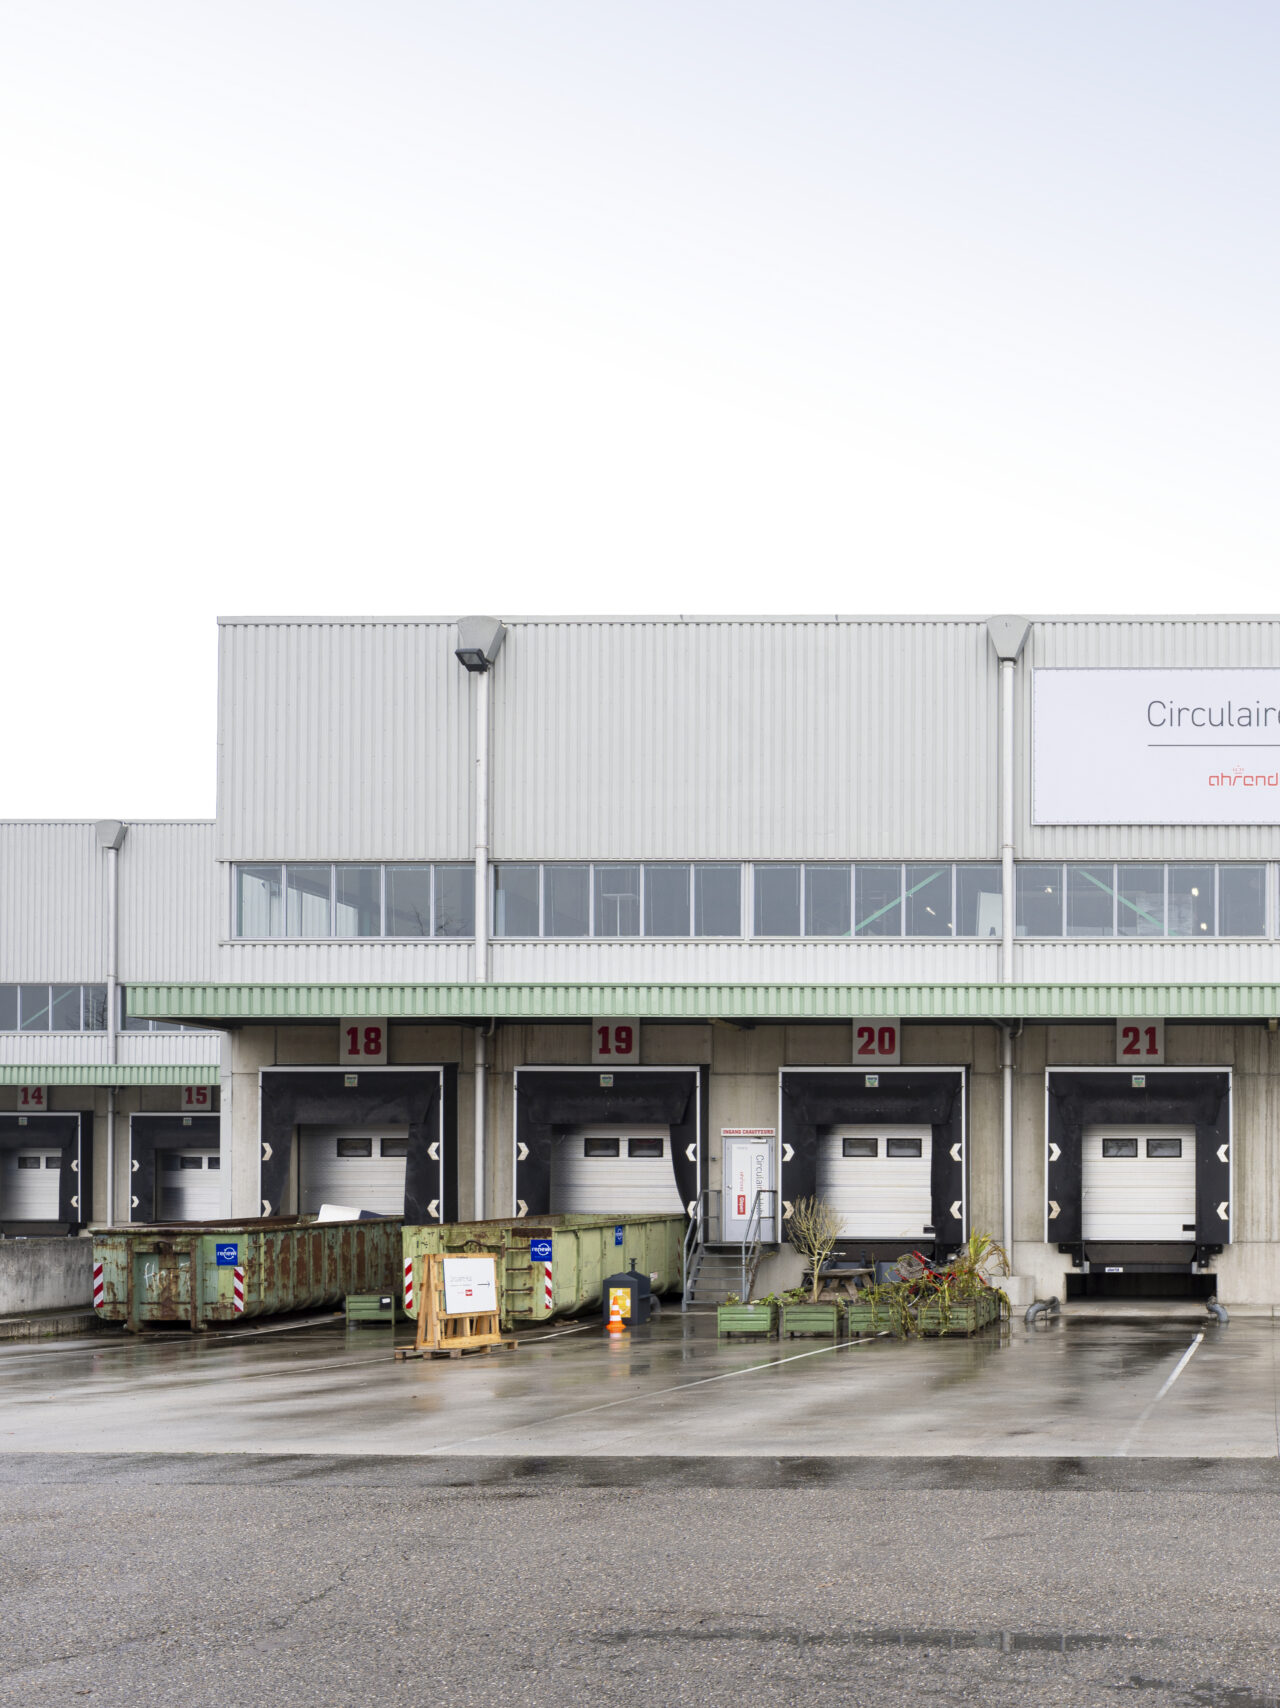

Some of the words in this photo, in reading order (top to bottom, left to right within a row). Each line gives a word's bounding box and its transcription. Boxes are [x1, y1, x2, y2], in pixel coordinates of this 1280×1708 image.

[1208, 772, 1279, 787] ahrend
[346, 1027, 381, 1055] 18
[598, 1026, 633, 1054] 19
[857, 1026, 896, 1055] 20
[1122, 1027, 1159, 1055] 21
[21, 1087, 43, 1105] 14
[185, 1087, 208, 1105] 15
[755, 1154, 765, 1196] Circulair
